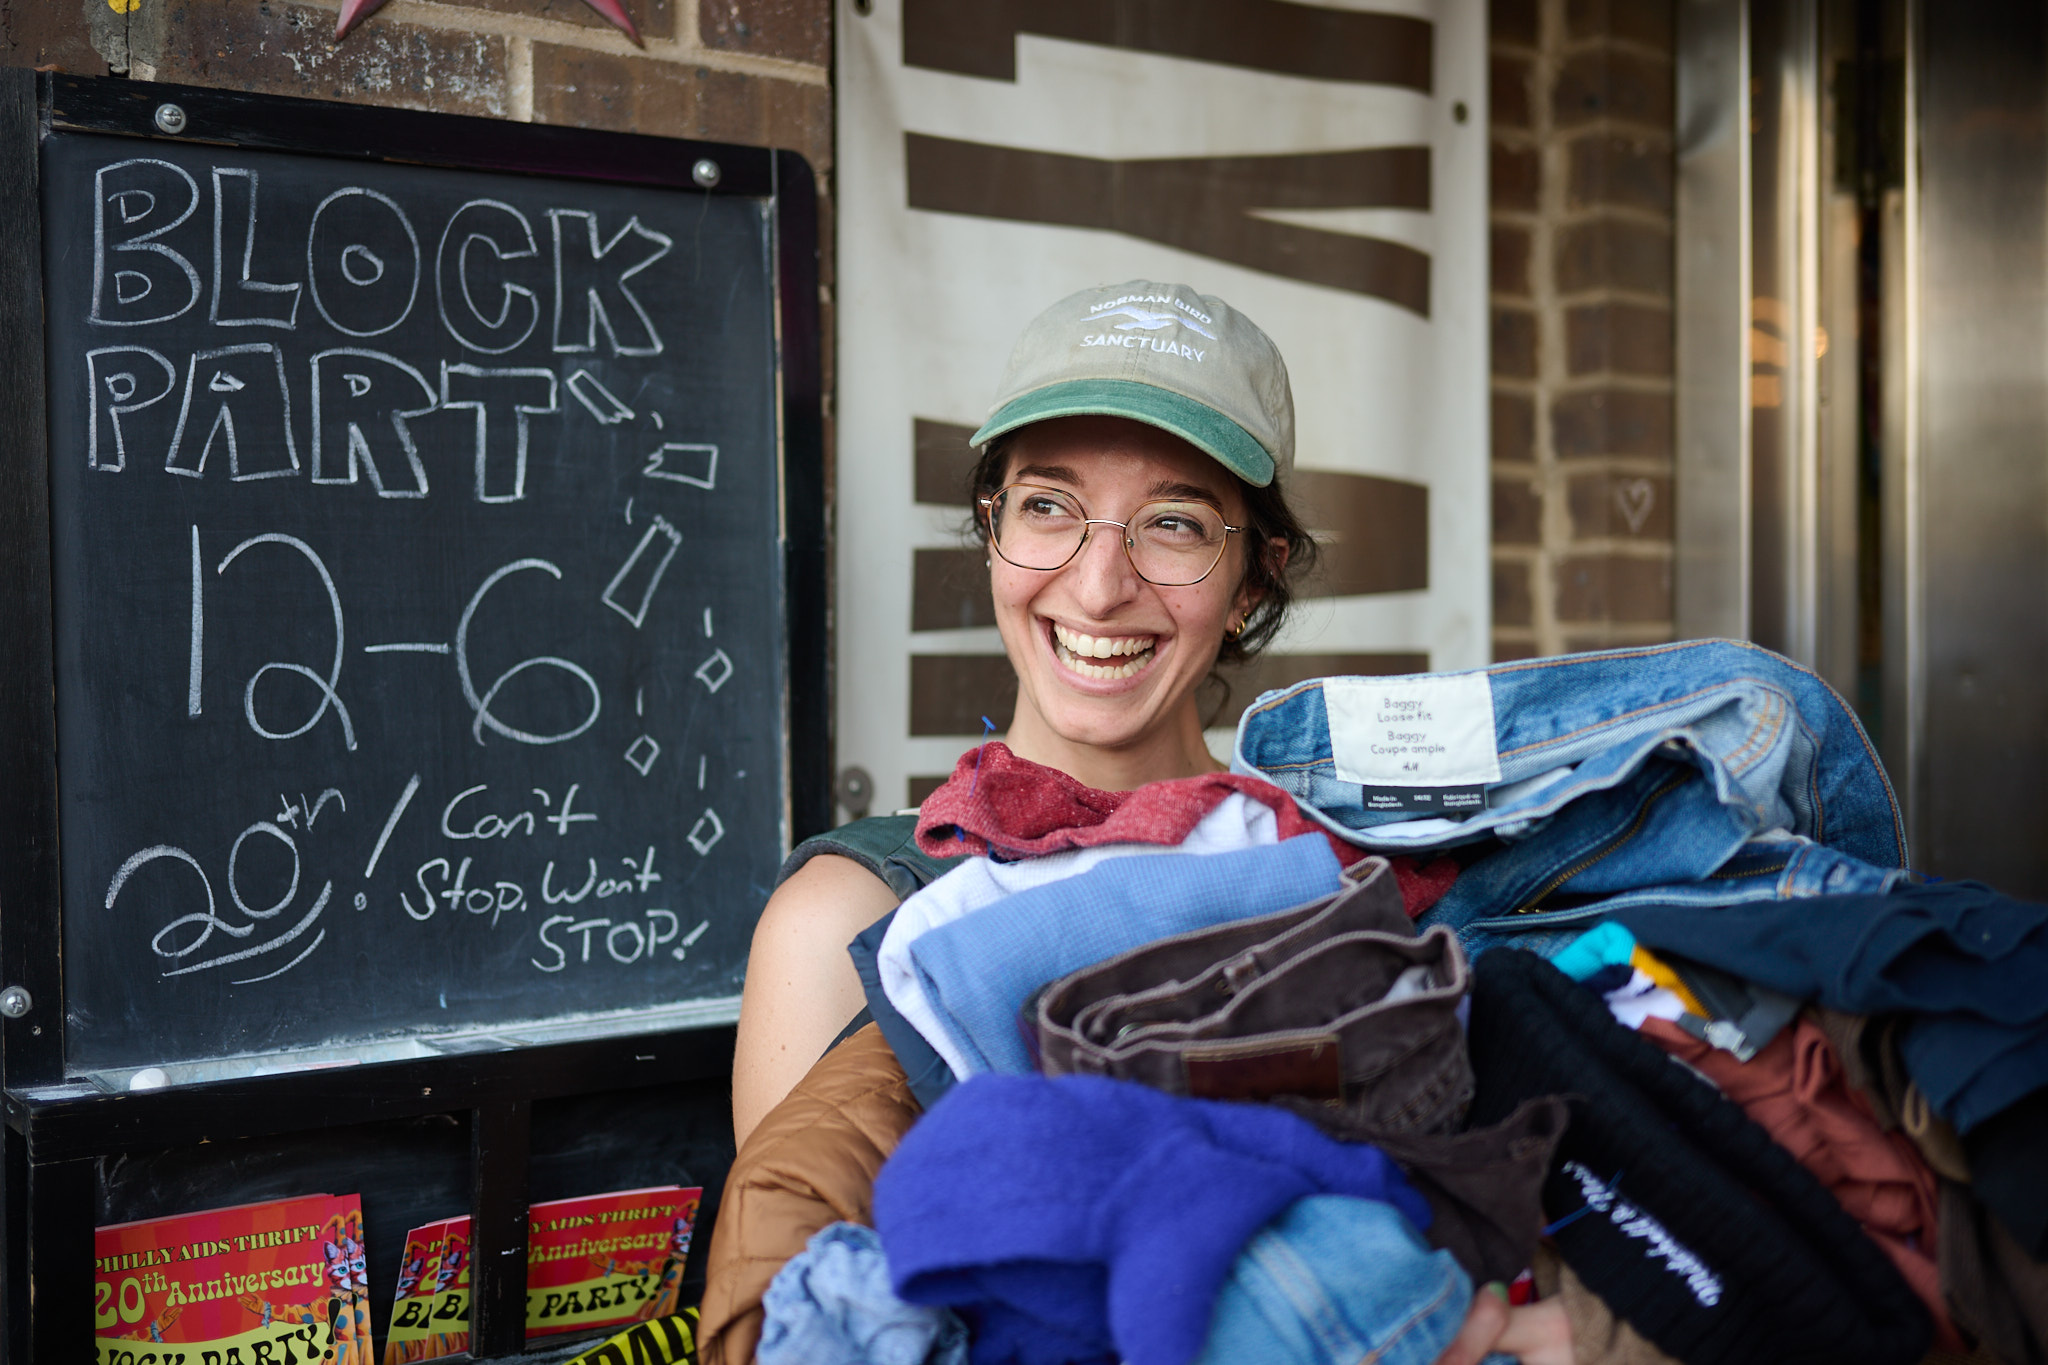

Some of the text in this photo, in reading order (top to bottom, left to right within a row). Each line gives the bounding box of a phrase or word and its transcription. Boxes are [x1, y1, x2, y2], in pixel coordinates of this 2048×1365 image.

[88, 158, 673, 356] BLOCK
[1089, 294, 1212, 325] NORMAN BIRD
[1079, 333, 1206, 363] SANCTUARY
[1377, 710, 1433, 723] Loose fit
[1383, 697, 1424, 711] Baggy
[1370, 743, 1446, 756] Coupe ample
[1386, 730, 1427, 743] Baggy
[441, 783, 599, 840] Can't
[541, 845, 662, 904] Won't
[531, 908, 711, 972] STOP!
[547, 1213, 595, 1233] AIDS
[598, 1205, 677, 1225] THRIFT
[177, 1238, 232, 1262] AIDS
[233, 1223, 321, 1252] THRIFT
[528, 1231, 673, 1265] Anniversary
[165, 1261, 326, 1308] Anniversary
[538, 1258, 677, 1319] PARTY!
